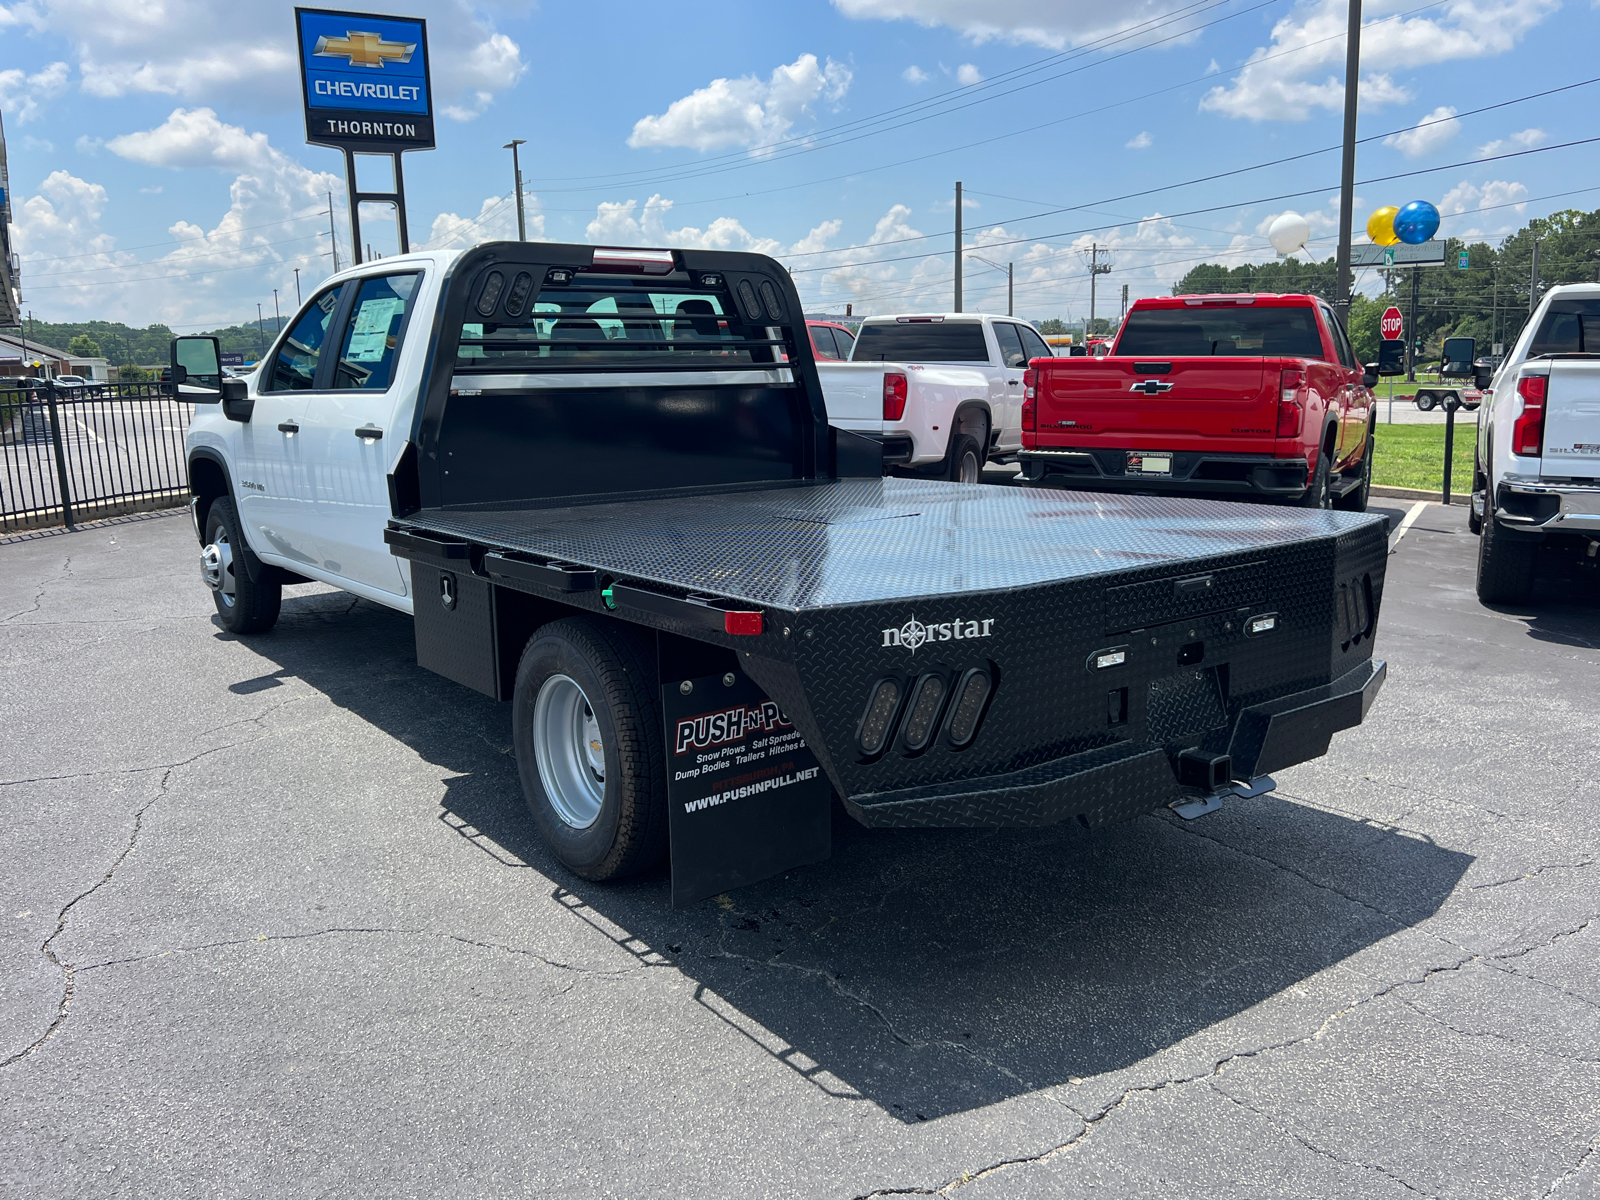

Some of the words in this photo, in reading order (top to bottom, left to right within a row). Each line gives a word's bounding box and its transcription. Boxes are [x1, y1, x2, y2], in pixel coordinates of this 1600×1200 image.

[314, 80, 420, 101] CHEVROLET
[327, 119, 416, 137] THORNTON
[1382, 317, 1401, 332] STOP
[881, 615, 994, 653] norstar
[735, 751, 765, 765] Trailers
[769, 742, 799, 756] Hitches
[752, 737, 768, 750] Salt
[696, 752, 720, 764] Snow
[721, 745, 746, 758] Plows
[675, 768, 700, 781] Dump
[702, 759, 730, 774] Bodies
[712, 765, 782, 791] PITTSBURGH,
[781, 761, 795, 772] PA
[684, 766, 820, 814] WWW.PUSHNPULL.NET
